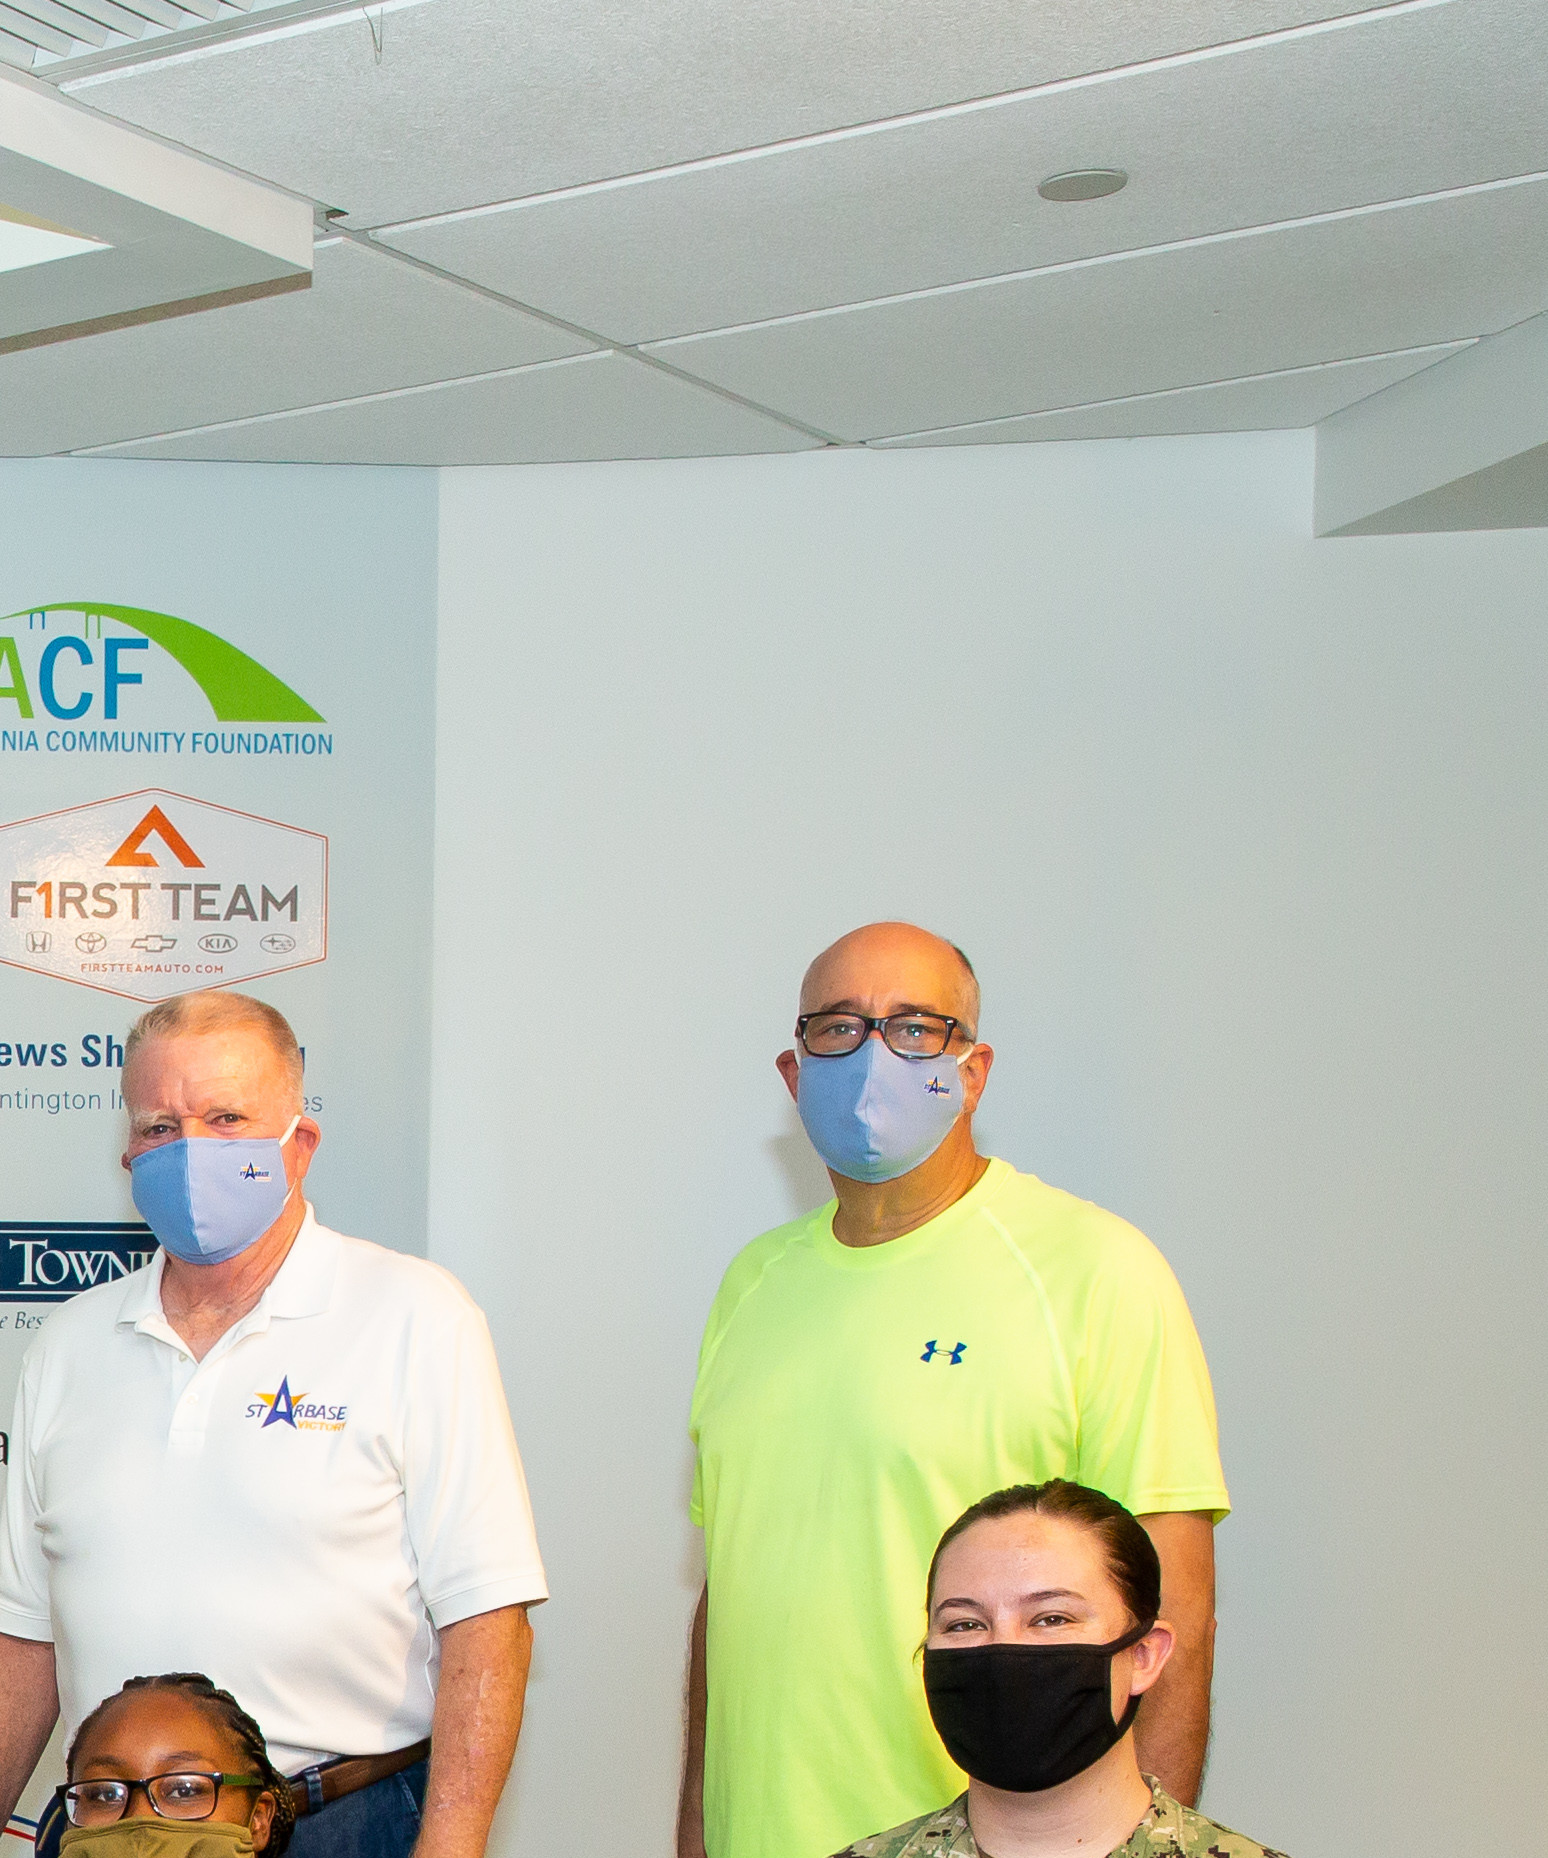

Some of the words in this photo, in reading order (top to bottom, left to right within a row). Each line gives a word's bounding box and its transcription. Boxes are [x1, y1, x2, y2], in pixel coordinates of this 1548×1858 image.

[46, 731, 186, 754] COMMUNITY
[192, 732, 334, 755] FOUNDATION
[161, 882, 299, 922] TEAM
[9, 1239, 153, 1285] TOWN
[15, 1311, 48, 1330] Bes
